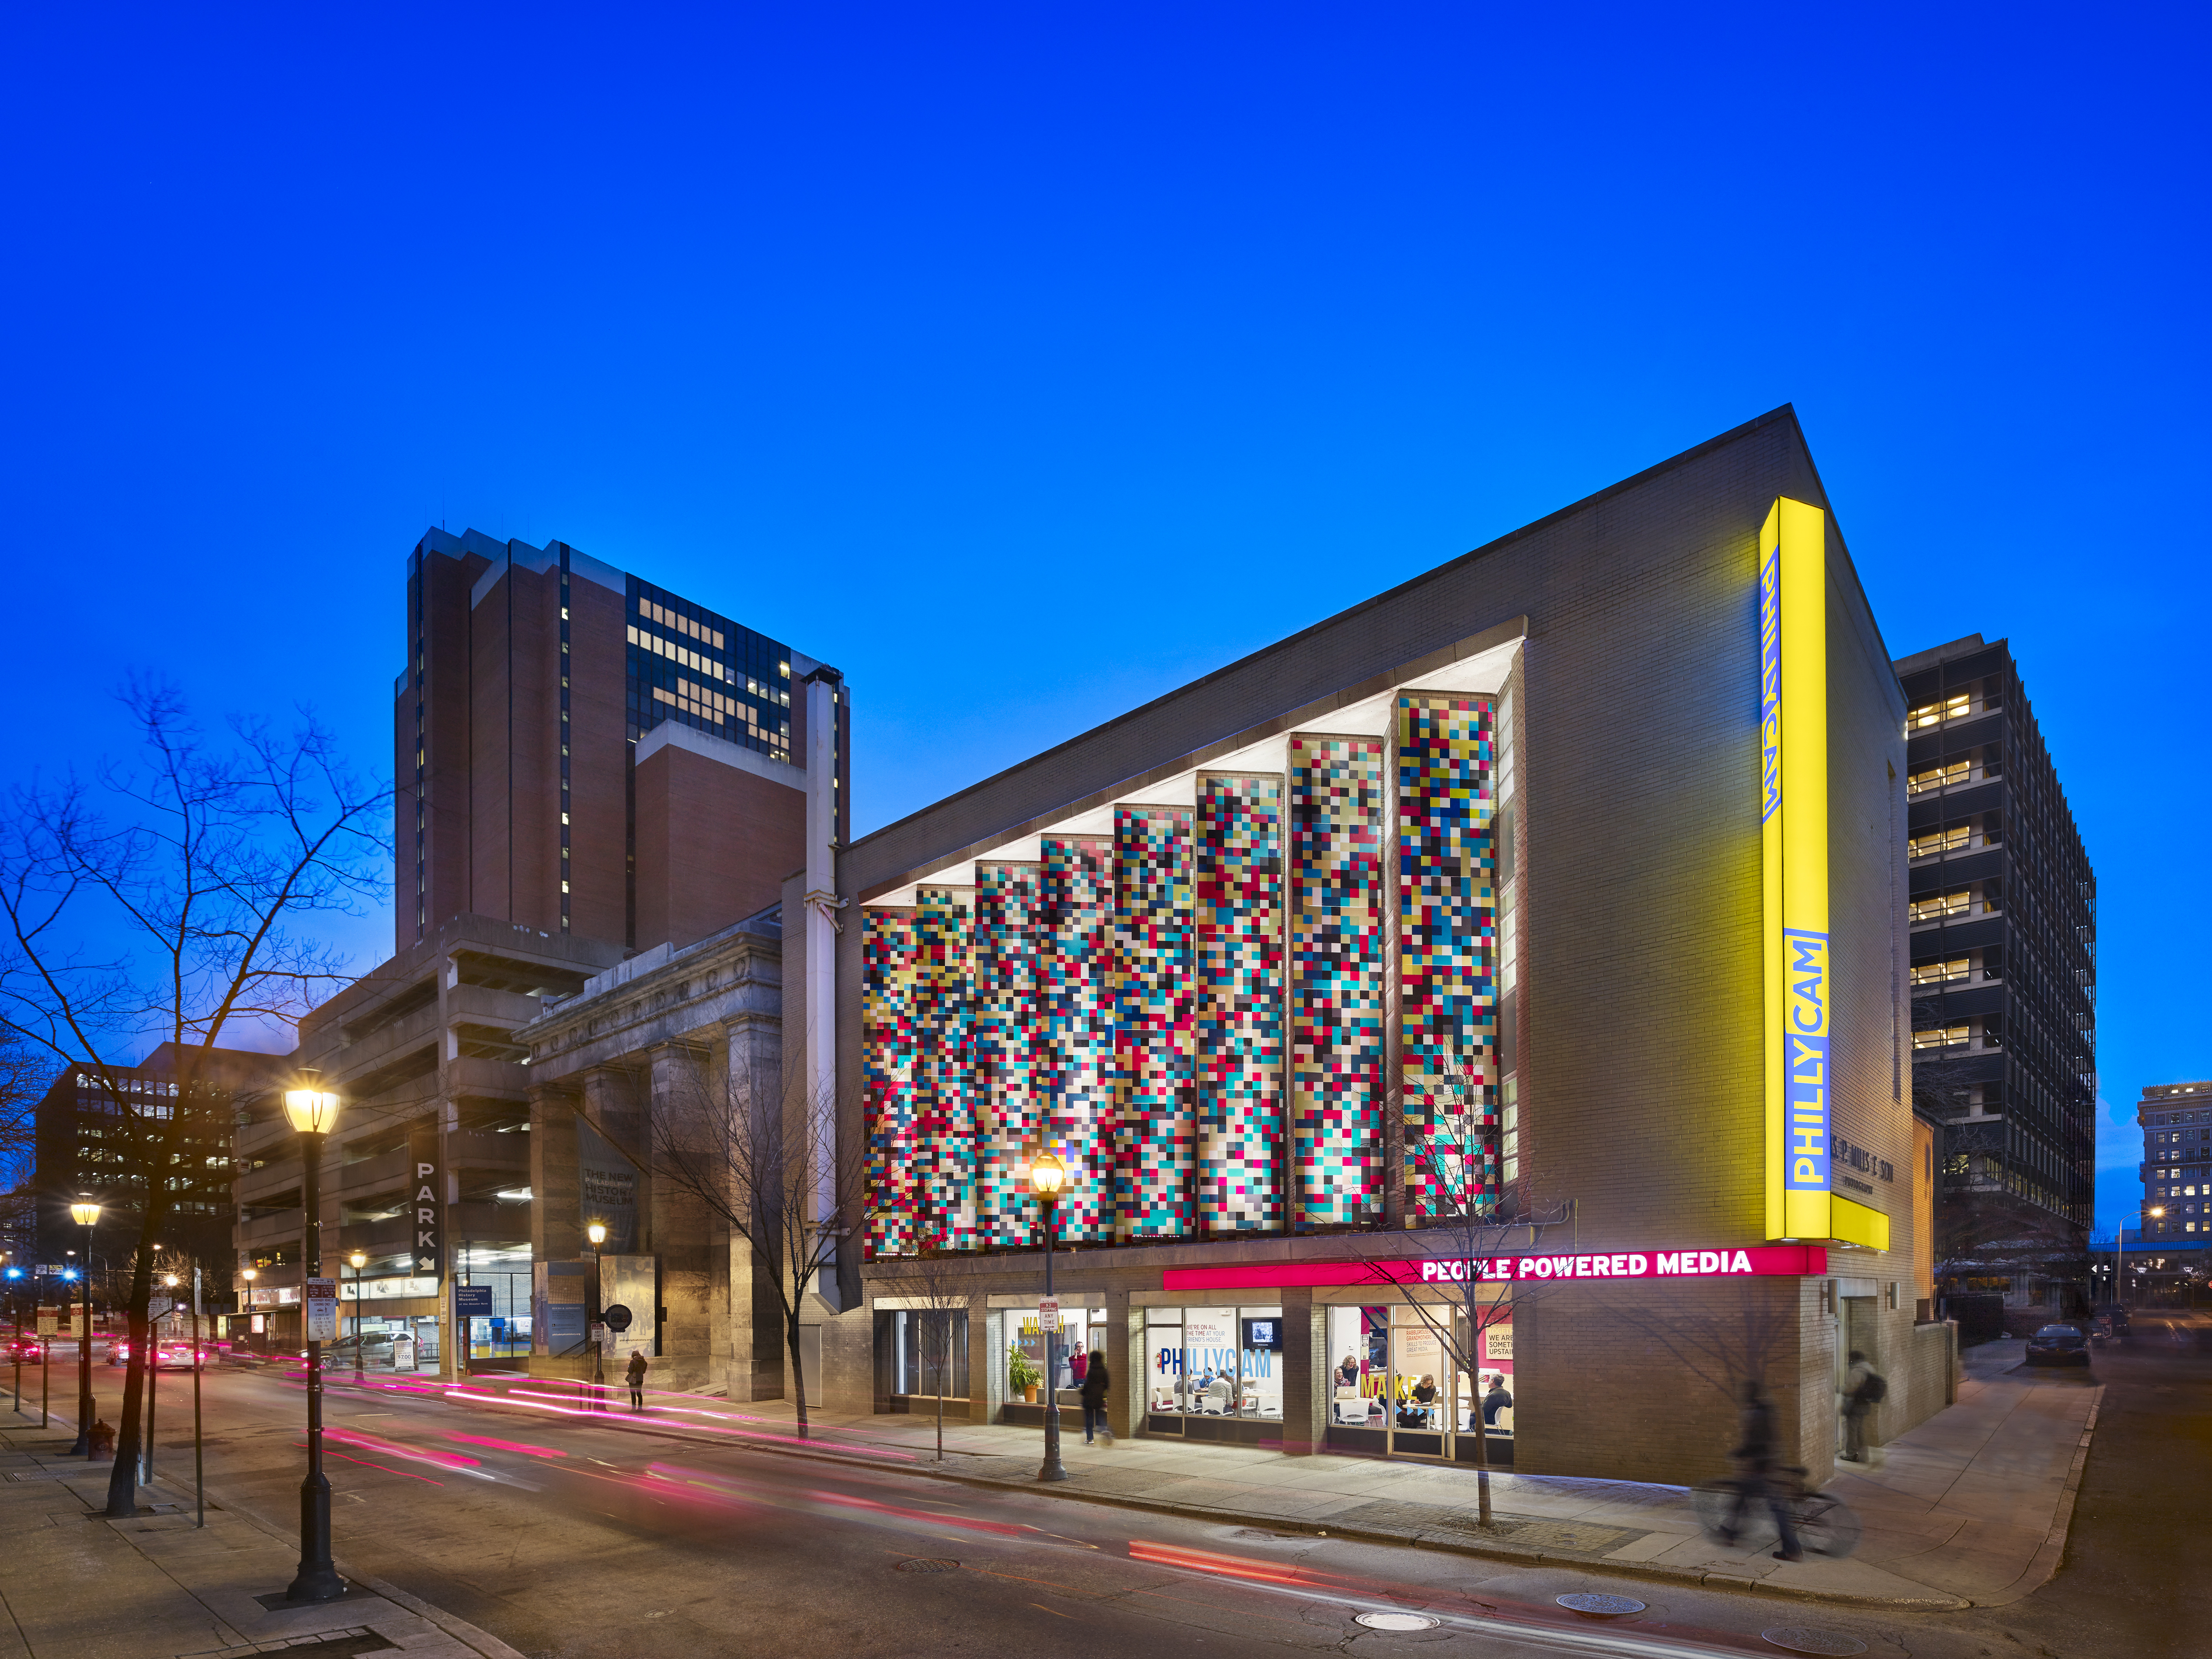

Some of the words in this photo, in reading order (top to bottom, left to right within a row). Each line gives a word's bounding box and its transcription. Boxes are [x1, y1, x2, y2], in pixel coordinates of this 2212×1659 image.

[1761, 558, 1782, 809] PHILLYCAM
[1792, 940, 1823, 1183] PHILLYCAM
[1842, 1140, 1847, 1163] P.
[1851, 1145, 1869, 1172] MILLS
[1881, 1160, 1893, 1183] SON
[585, 1168, 606, 1179] THE
[609, 1173, 633, 1181] NEW
[585, 1178, 633, 1187] PHILADELPHIA
[586, 1183, 633, 1196] HISTORY
[1844, 1176, 1873, 1195] PHOTOGRAPHY
[416, 1163, 436, 1247] PARK
[586, 1193, 632, 1205] MUSEUM
[1423, 1259, 1511, 1280] PEOPLE
[1519, 1254, 1647, 1278] POWERED
[1657, 1251, 1753, 1274] MEDIA
[257, 1293, 267, 1302] DONUTS
[285, 1291, 298, 1300] DONUTS
[1023, 1315, 1064, 1335] WAH
[1161, 1348, 1270, 1378] PHILLYCAM
[1361, 1374, 1417, 1400] MAKE
